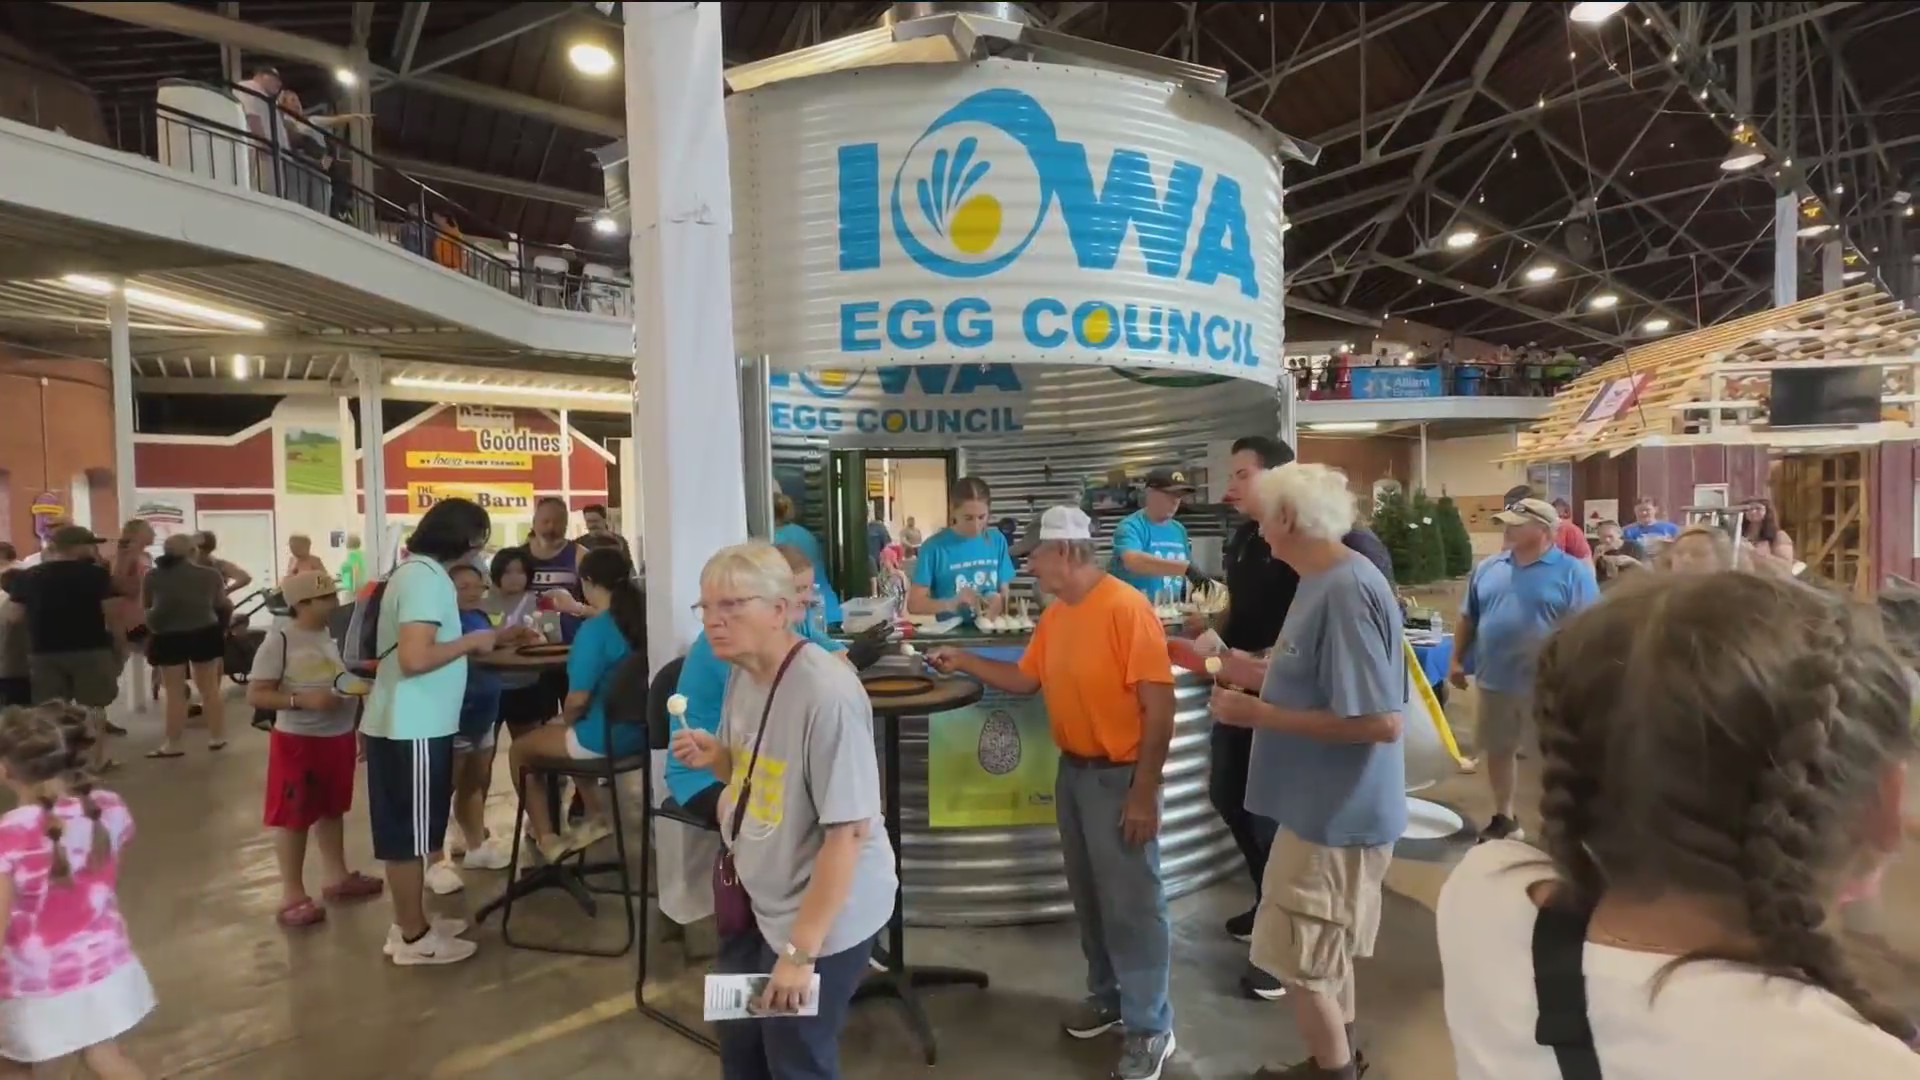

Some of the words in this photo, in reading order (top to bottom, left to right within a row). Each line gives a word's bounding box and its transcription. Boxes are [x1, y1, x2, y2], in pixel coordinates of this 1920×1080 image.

[838, 88, 1260, 299] IOWA
[840, 298, 994, 352] EGG
[1022, 298, 1260, 367] COUNCIL
[770, 402, 843, 434] EGG
[856, 407, 1023, 433] COUNCIL
[480, 428, 571, 452] Goodnes
[477, 493, 528, 508] Barn
